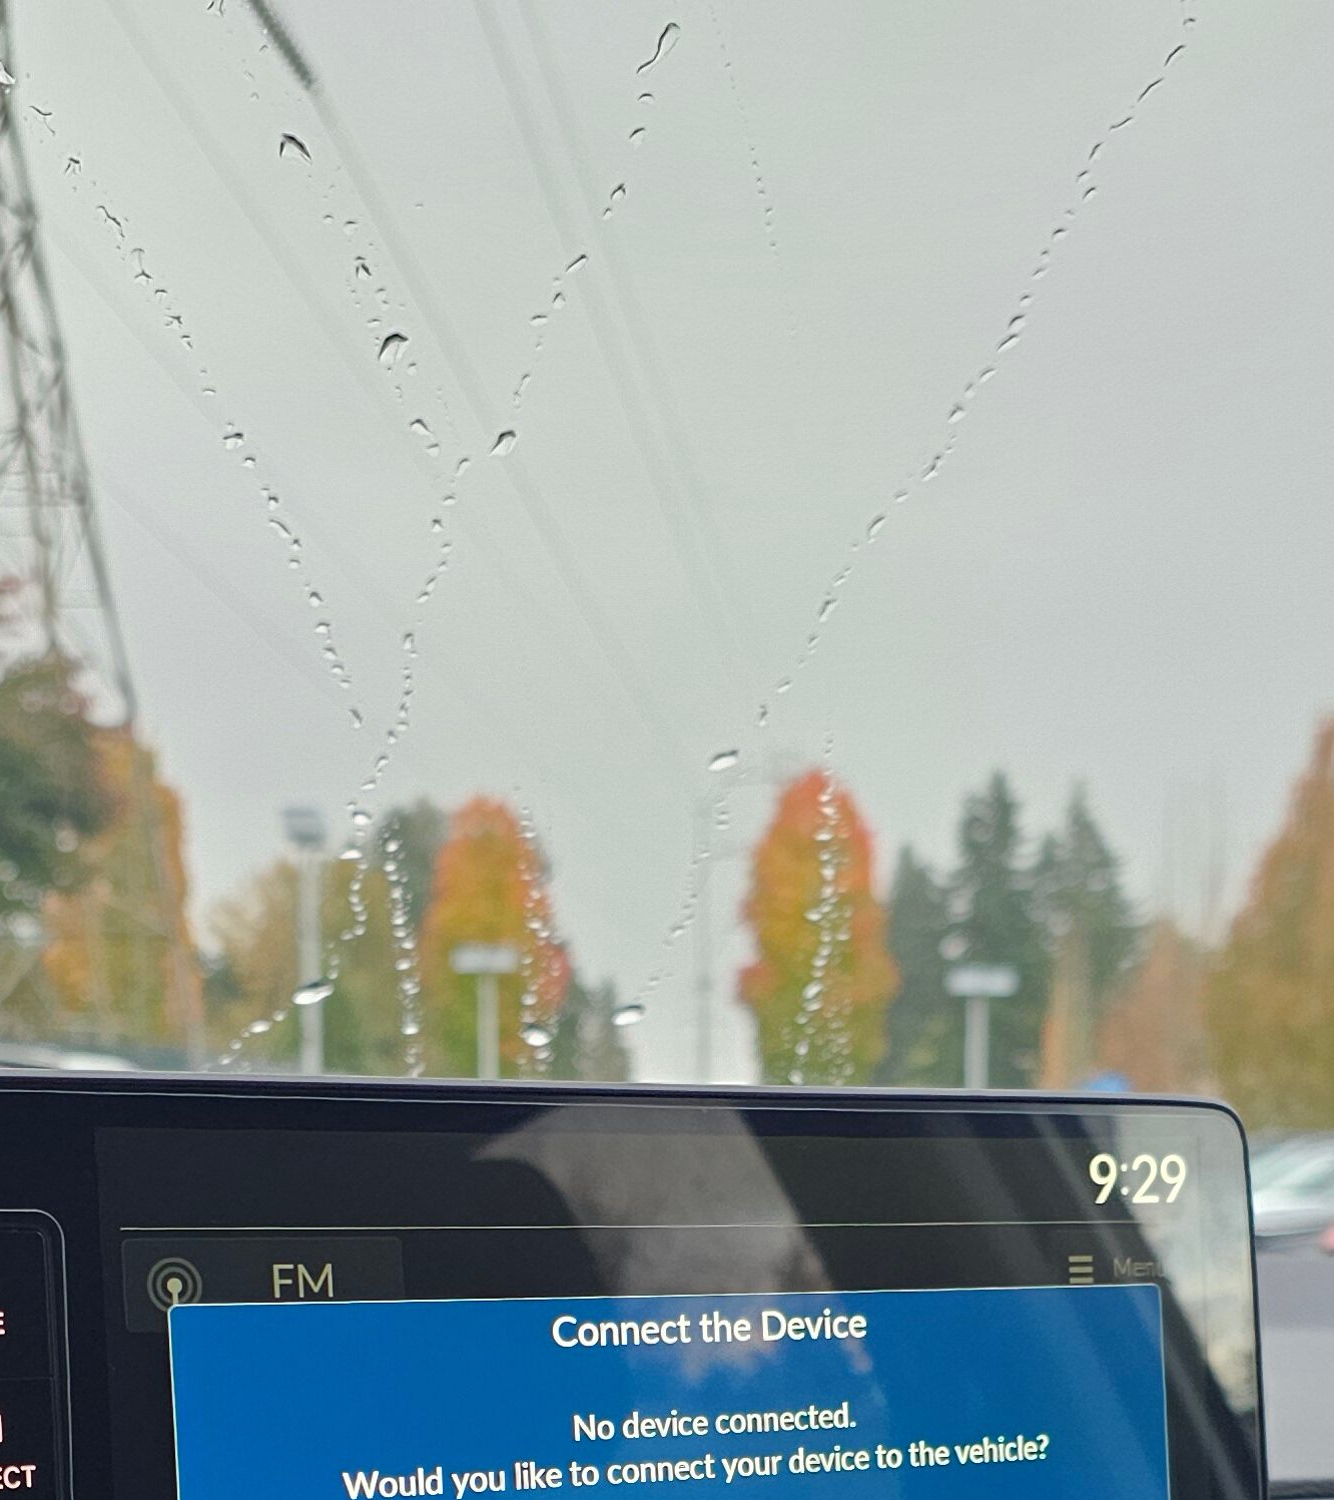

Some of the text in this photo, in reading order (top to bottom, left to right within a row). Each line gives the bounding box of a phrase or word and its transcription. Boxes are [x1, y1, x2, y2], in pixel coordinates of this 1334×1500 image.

[1089, 1153, 1187, 1204] 9:29
[272, 1263, 334, 1298] FM
[552, 1309, 867, 1348] Connect the Device
[573, 1402, 857, 1442] No device connected.
[342, 1434, 1050, 1500] Would you like to connect your device to the vehicle?
